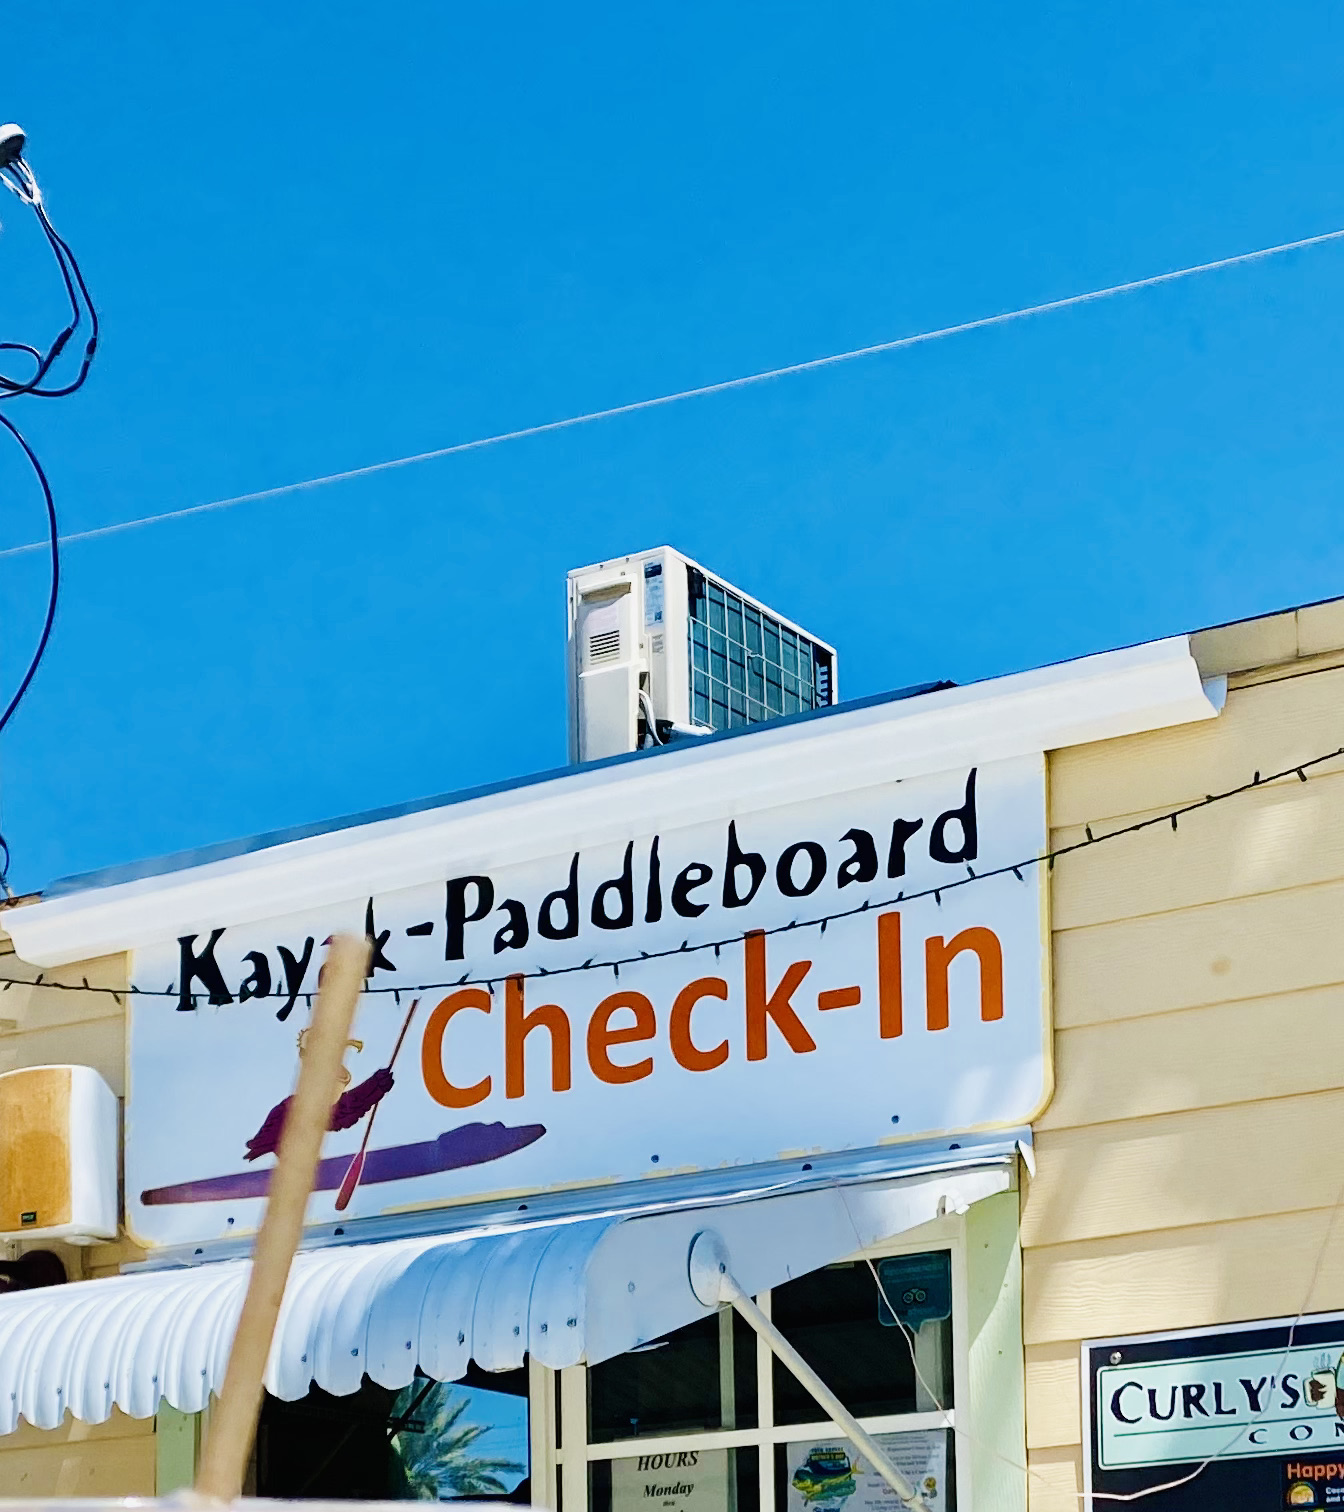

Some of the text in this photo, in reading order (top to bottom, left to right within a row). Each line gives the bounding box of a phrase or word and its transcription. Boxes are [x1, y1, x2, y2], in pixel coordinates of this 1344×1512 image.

[178, 766, 979, 1022] Kayk-Paddleboard
[421, 911, 1005, 1109] Check-In
[1109, 1373, 1301, 1425] CURLY'S
[637, 1450, 700, 1472] HOURS
[643, 1481, 695, 1498] Monday
